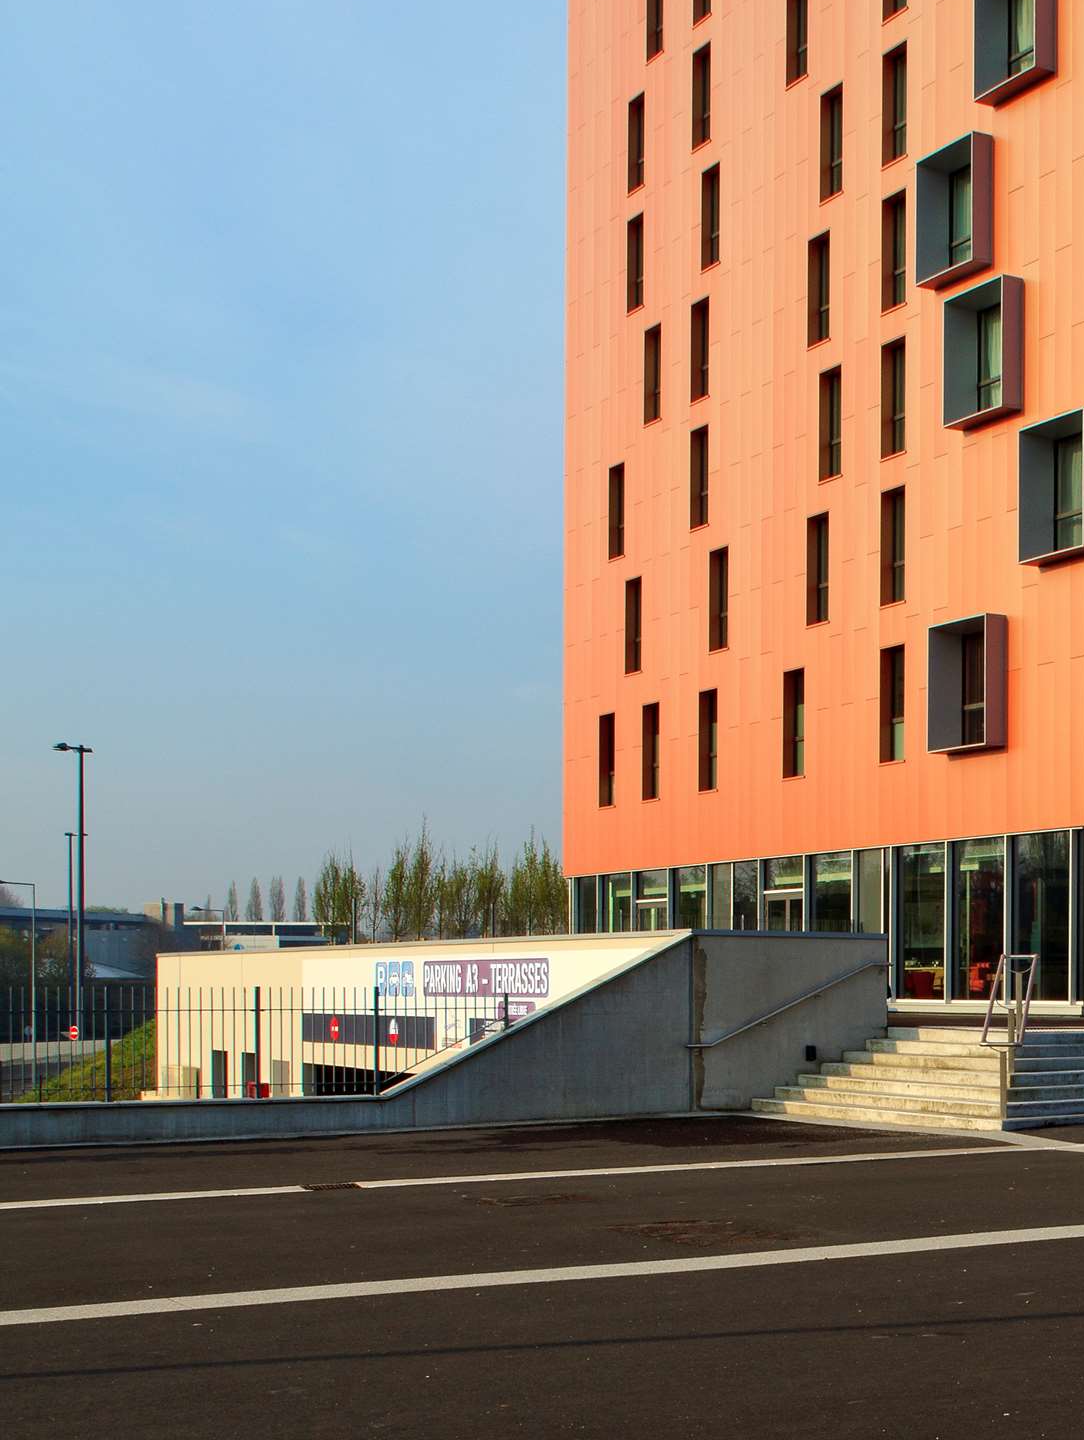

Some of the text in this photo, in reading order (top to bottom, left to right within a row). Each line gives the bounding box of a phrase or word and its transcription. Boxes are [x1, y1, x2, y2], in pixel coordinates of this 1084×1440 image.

[424, 963, 462, 994] PARKING
[465, 963, 479, 994] A3
[490, 962, 548, 994] TERRASSES
